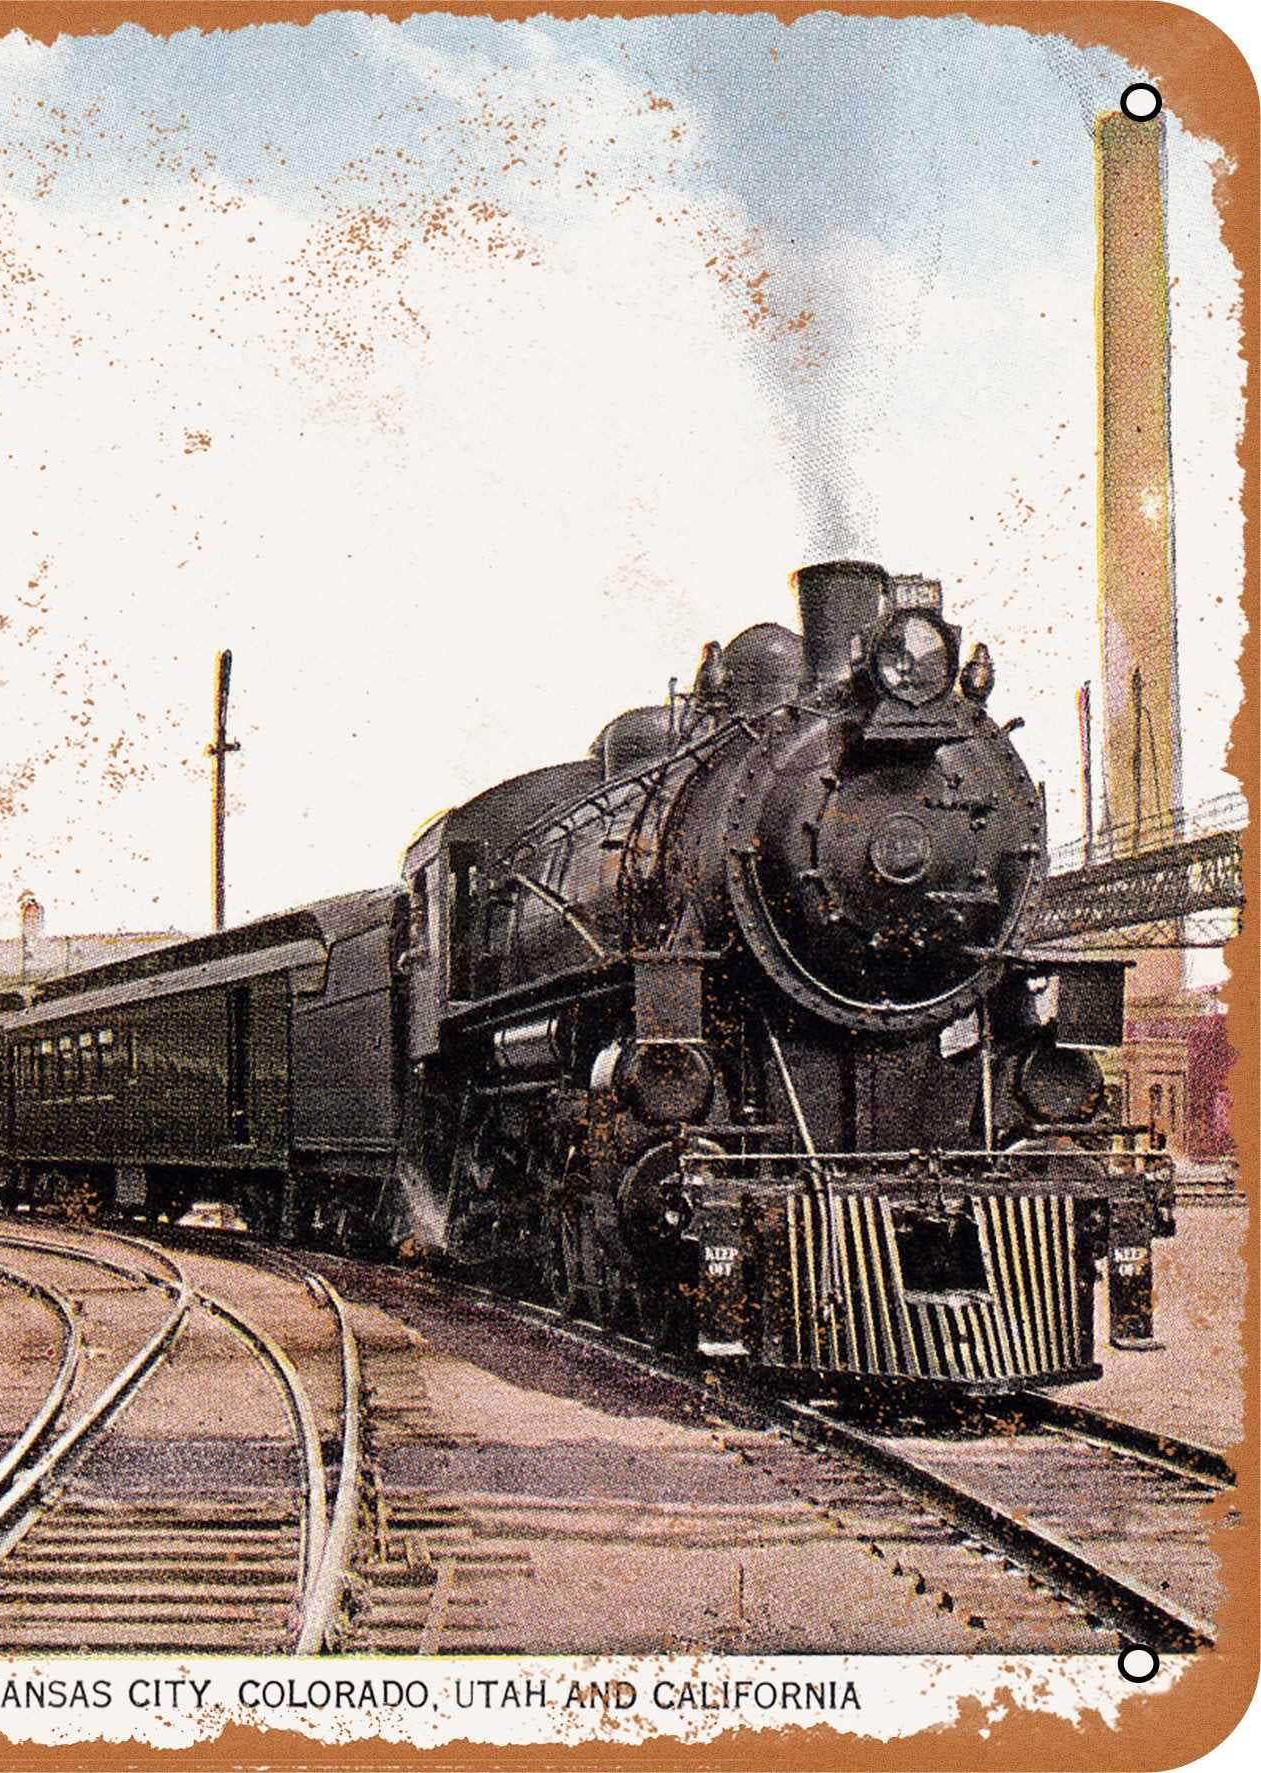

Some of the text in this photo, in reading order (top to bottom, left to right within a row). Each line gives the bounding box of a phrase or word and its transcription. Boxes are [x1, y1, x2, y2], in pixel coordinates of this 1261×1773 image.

[237, 1679, 438, 1713] COLORADO,
[455, 1679, 546, 1709] UTAH
[565, 1681, 637, 1709] AND
[652, 1680, 861, 1710] CALIFORNIA
